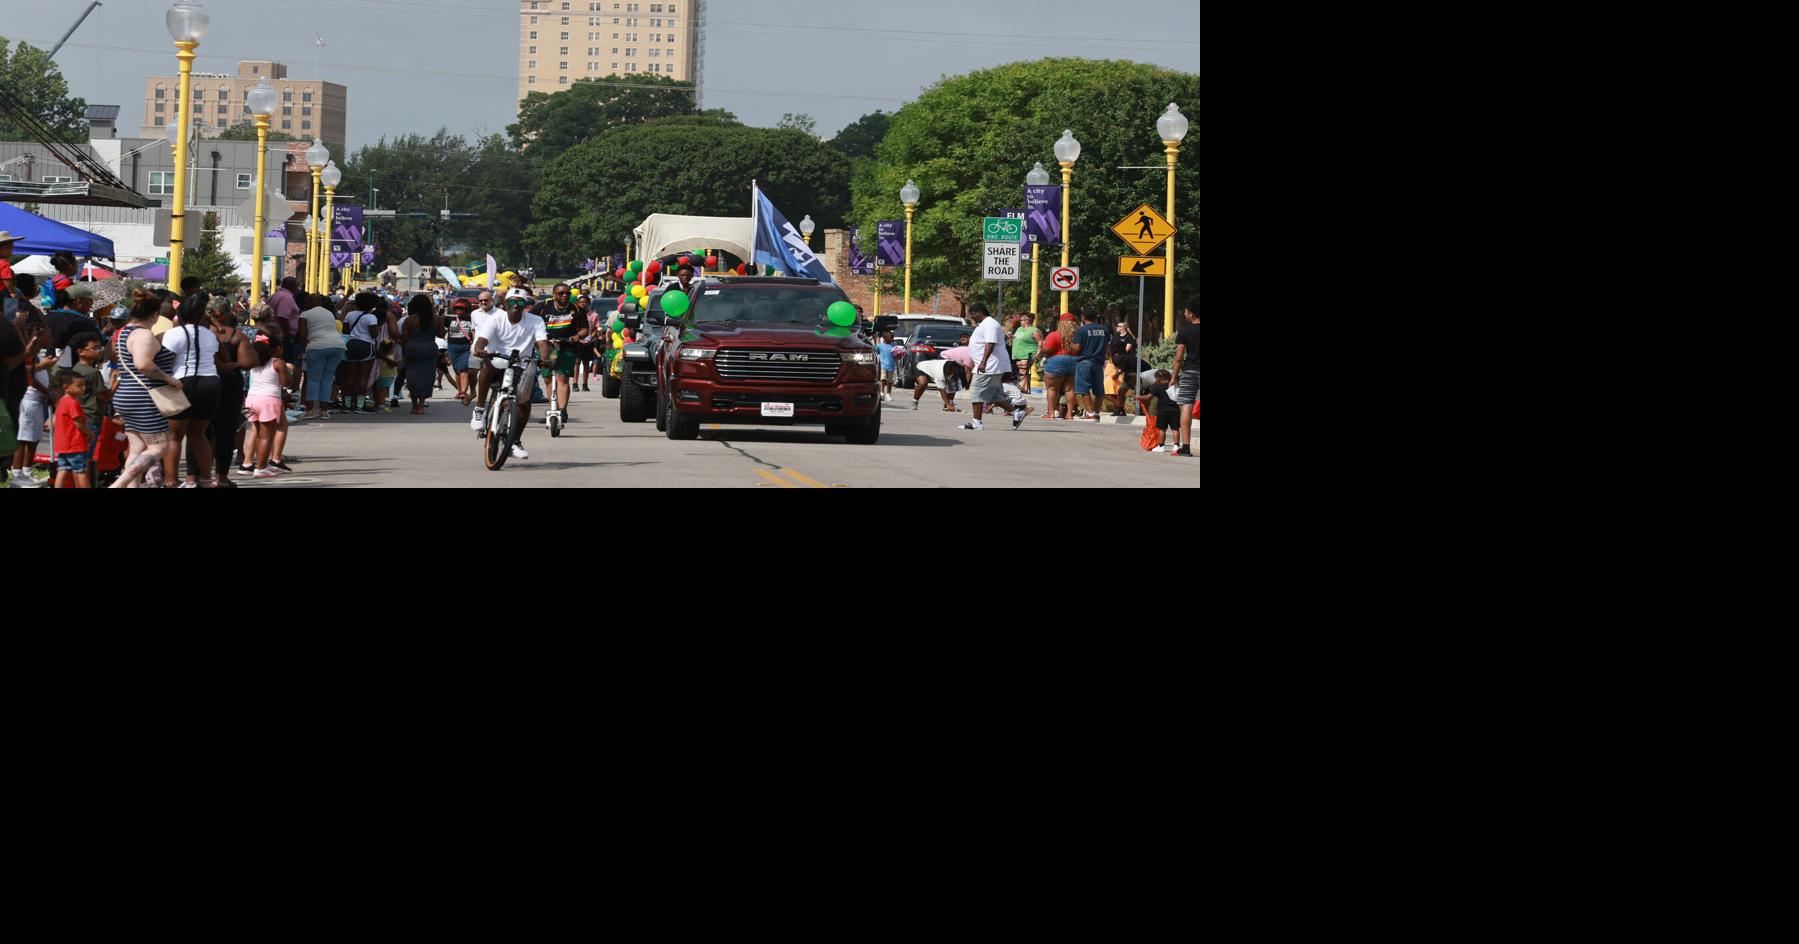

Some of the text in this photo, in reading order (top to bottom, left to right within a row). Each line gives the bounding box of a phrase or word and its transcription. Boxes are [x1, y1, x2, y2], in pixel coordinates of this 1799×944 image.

[987, 247, 1016, 256] SHARE
[994, 257, 1010, 265] THE
[988, 266, 1014, 275] ROAD
[749, 353, 808, 361] RAM
